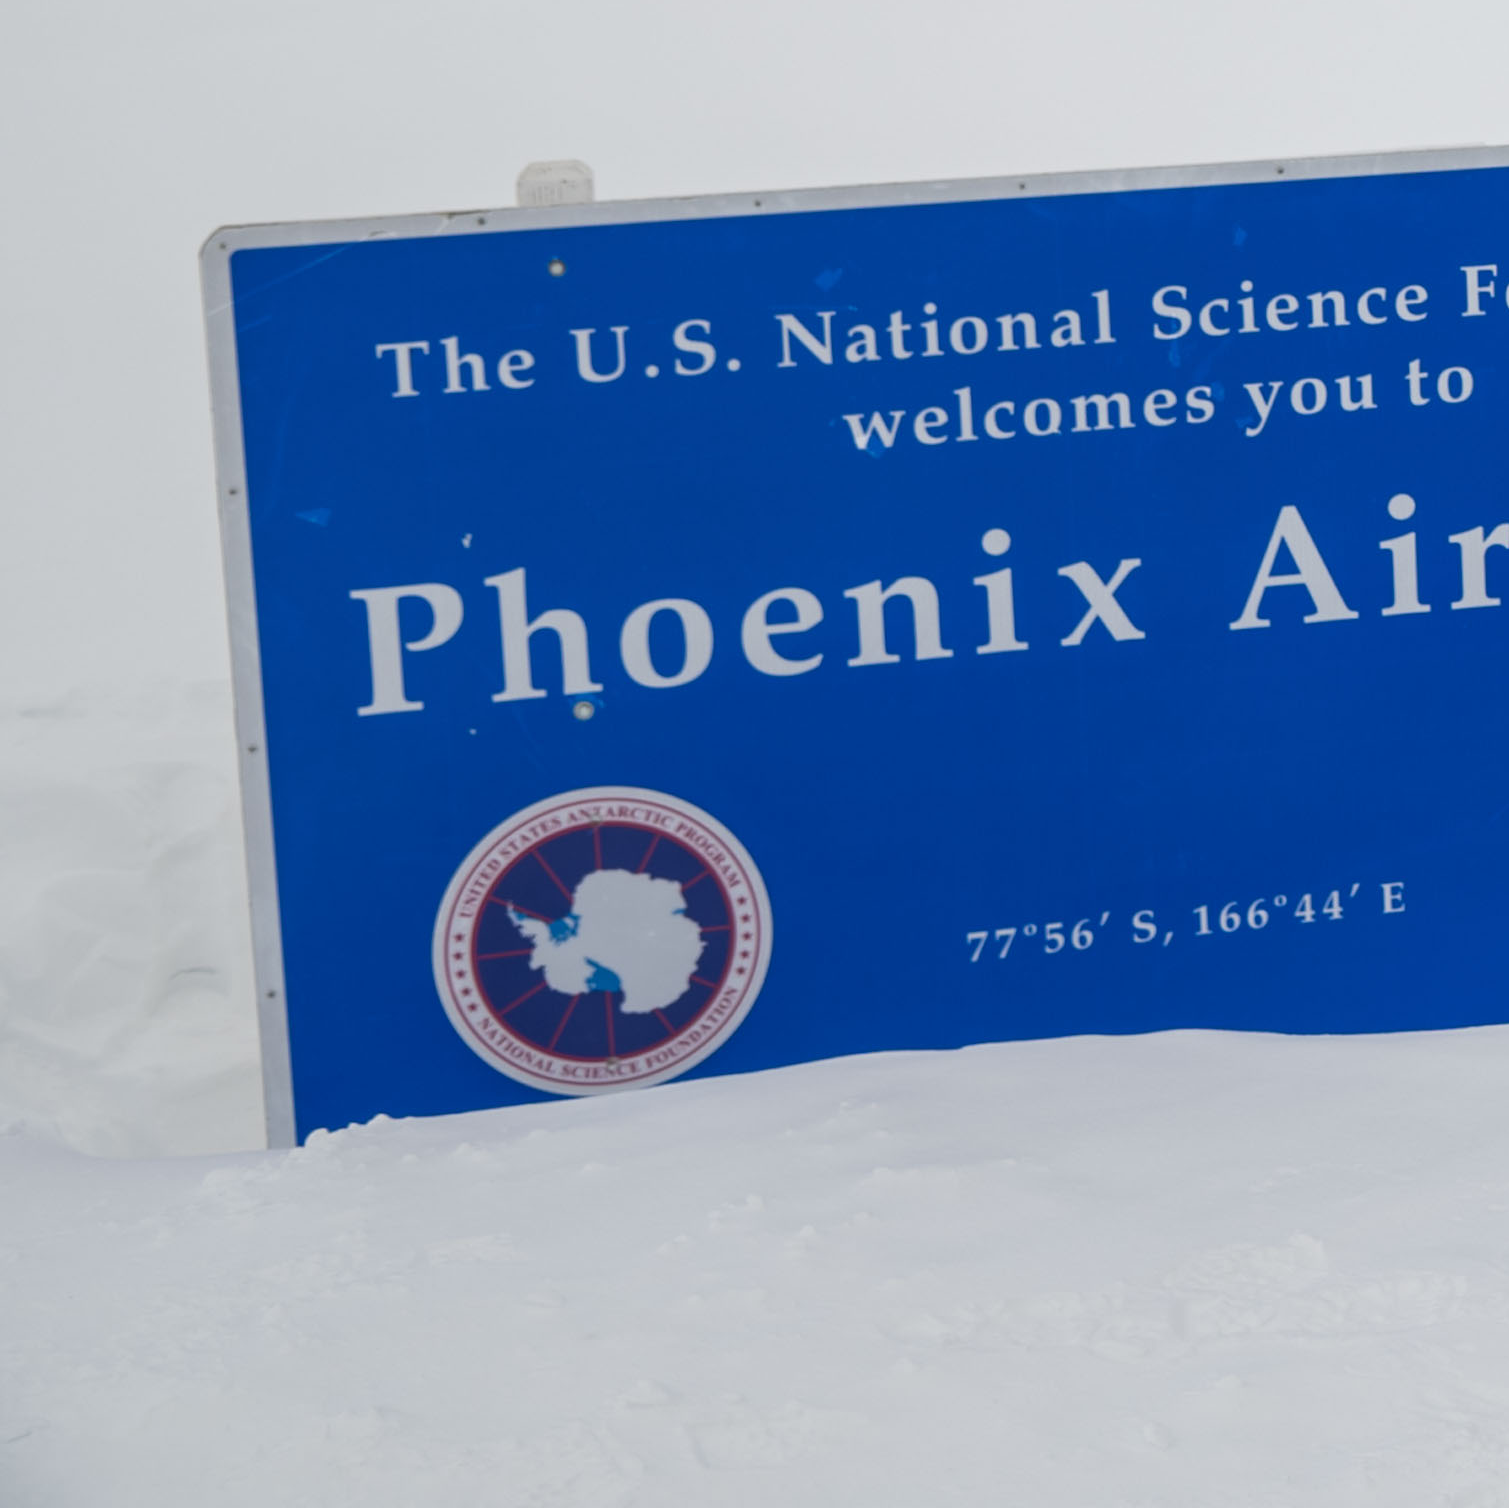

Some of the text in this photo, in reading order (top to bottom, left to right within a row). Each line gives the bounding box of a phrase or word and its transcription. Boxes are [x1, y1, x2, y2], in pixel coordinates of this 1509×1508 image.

[375, 336, 535, 398] The
[570, 319, 741, 383] U.S.
[775, 289, 1116, 368] National
[1152, 279, 1428, 340] Science
[842, 358, 1474, 450] welcomes you to
[349, 528, 1146, 717] Phoenix
[459, 805, 741, 919] UNITED STATES ANTARCTIC PROGRAM
[1131, 909, 1175, 947] S,
[1381, 882, 1407, 914] E
[476, 986, 739, 1080] NATIONAL SCIENCE FOUNDATION
